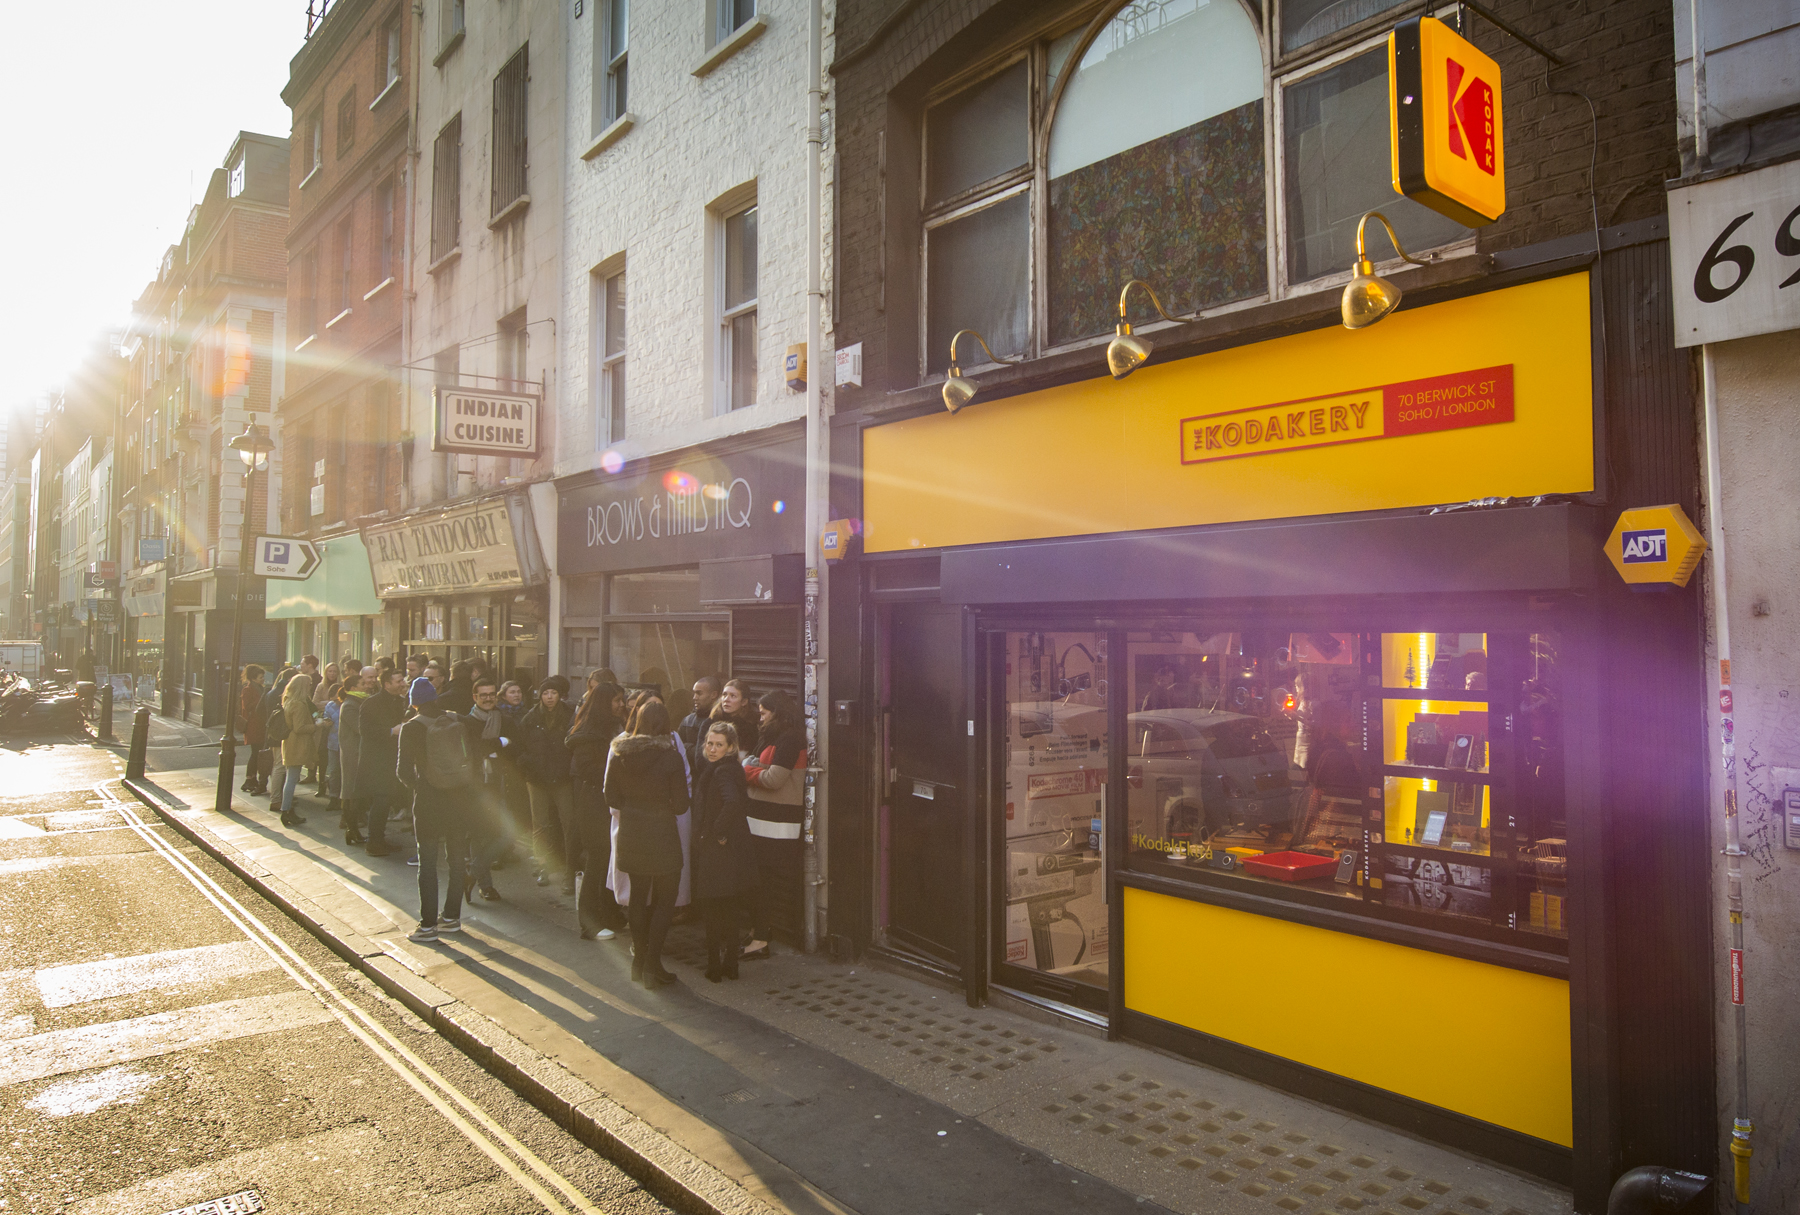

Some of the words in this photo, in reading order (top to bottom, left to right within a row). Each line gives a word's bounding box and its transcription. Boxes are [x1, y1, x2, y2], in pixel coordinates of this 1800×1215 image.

[1483, 89, 1492, 168] KODAK
[1397, 393, 1414, 407] 70
[1416, 385, 1476, 405] BERWICK
[1479, 380, 1496, 394] ST
[456, 398, 523, 421] INDIAN
[1398, 407, 1430, 423] SOHO
[1442, 398, 1496, 416] LONDON
[454, 422, 524, 444] CUISINE
[1193, 428, 1203, 450] THE
[1205, 401, 1370, 450] KODAKERY
[587, 497, 645, 548] BROWS
[649, 494, 662, 538] &
[667, 484, 708, 537] NAILS
[715, 477, 752, 530] HQ
[377, 531, 408, 565] RAJ
[411, 512, 500, 557] TANDOORI
[824, 535, 838, 547] ADT
[1623, 534, 1666, 558] ADT
[269, 543, 285, 562] P
[398, 558, 480, 589] RESTAURANT
[231, 593, 264, 601] NDIE
[1074, 773, 1084, 782] 40
[1508, 815, 1515, 827] 27
[1131, 833, 1213, 860] #KodakEktra
